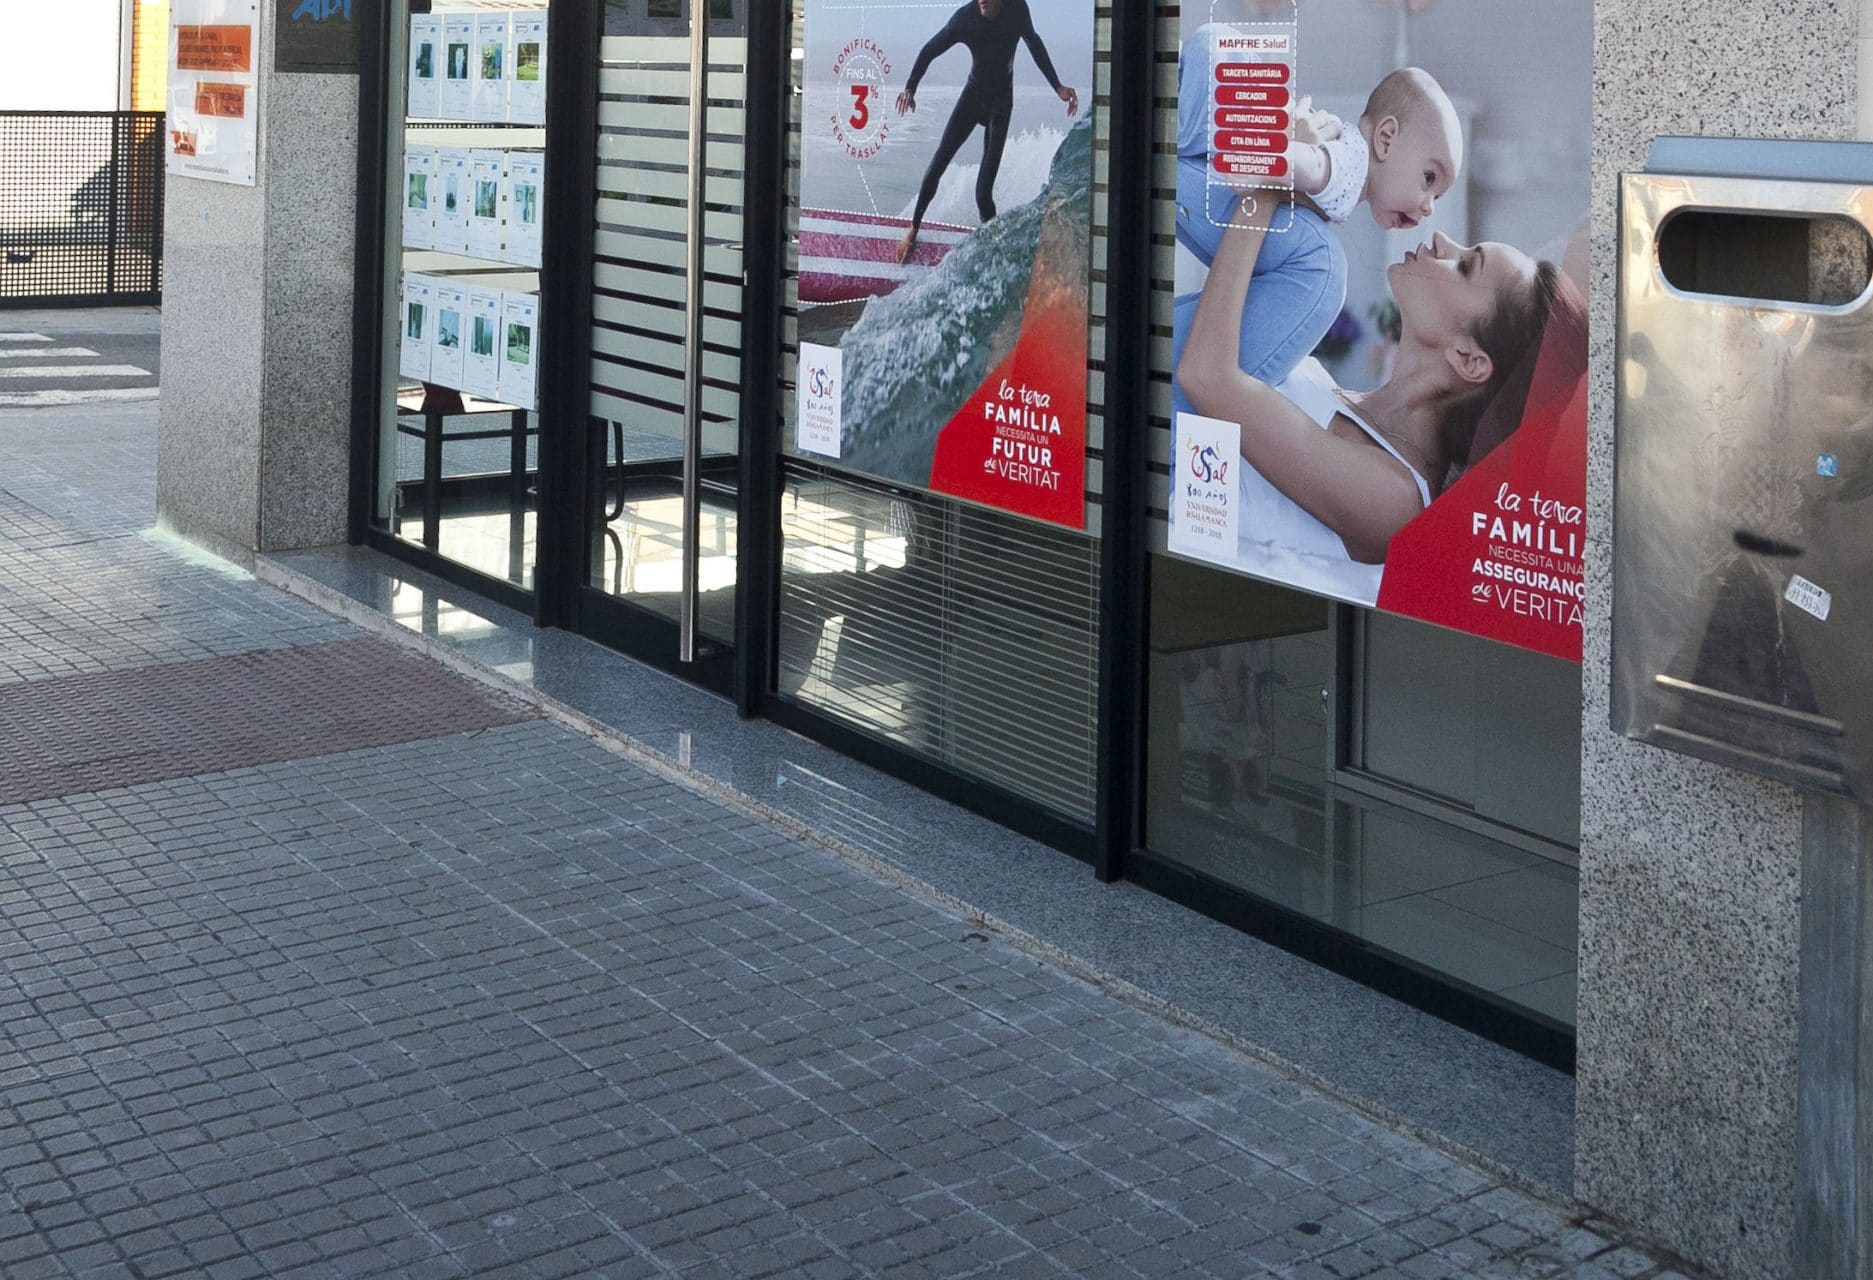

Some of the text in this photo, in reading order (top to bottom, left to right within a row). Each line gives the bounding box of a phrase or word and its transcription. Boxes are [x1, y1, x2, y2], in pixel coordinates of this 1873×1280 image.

[1219, 38, 1287, 49] MAPFRE Salud
[846, 68, 877, 80] FINS AL
[998, 379, 1014, 401] la
[985, 402, 1061, 435] FAMÍLIA
[996, 425, 1049, 445] NECESSITA UN
[993, 437, 1051, 468] FUTUR
[998, 459, 1061, 491] VERITAT
[1494, 482, 1521, 512] la
[1472, 512, 1585, 560] FAMÍLI
[1489, 544, 1585, 577] NECESSITA UNA
